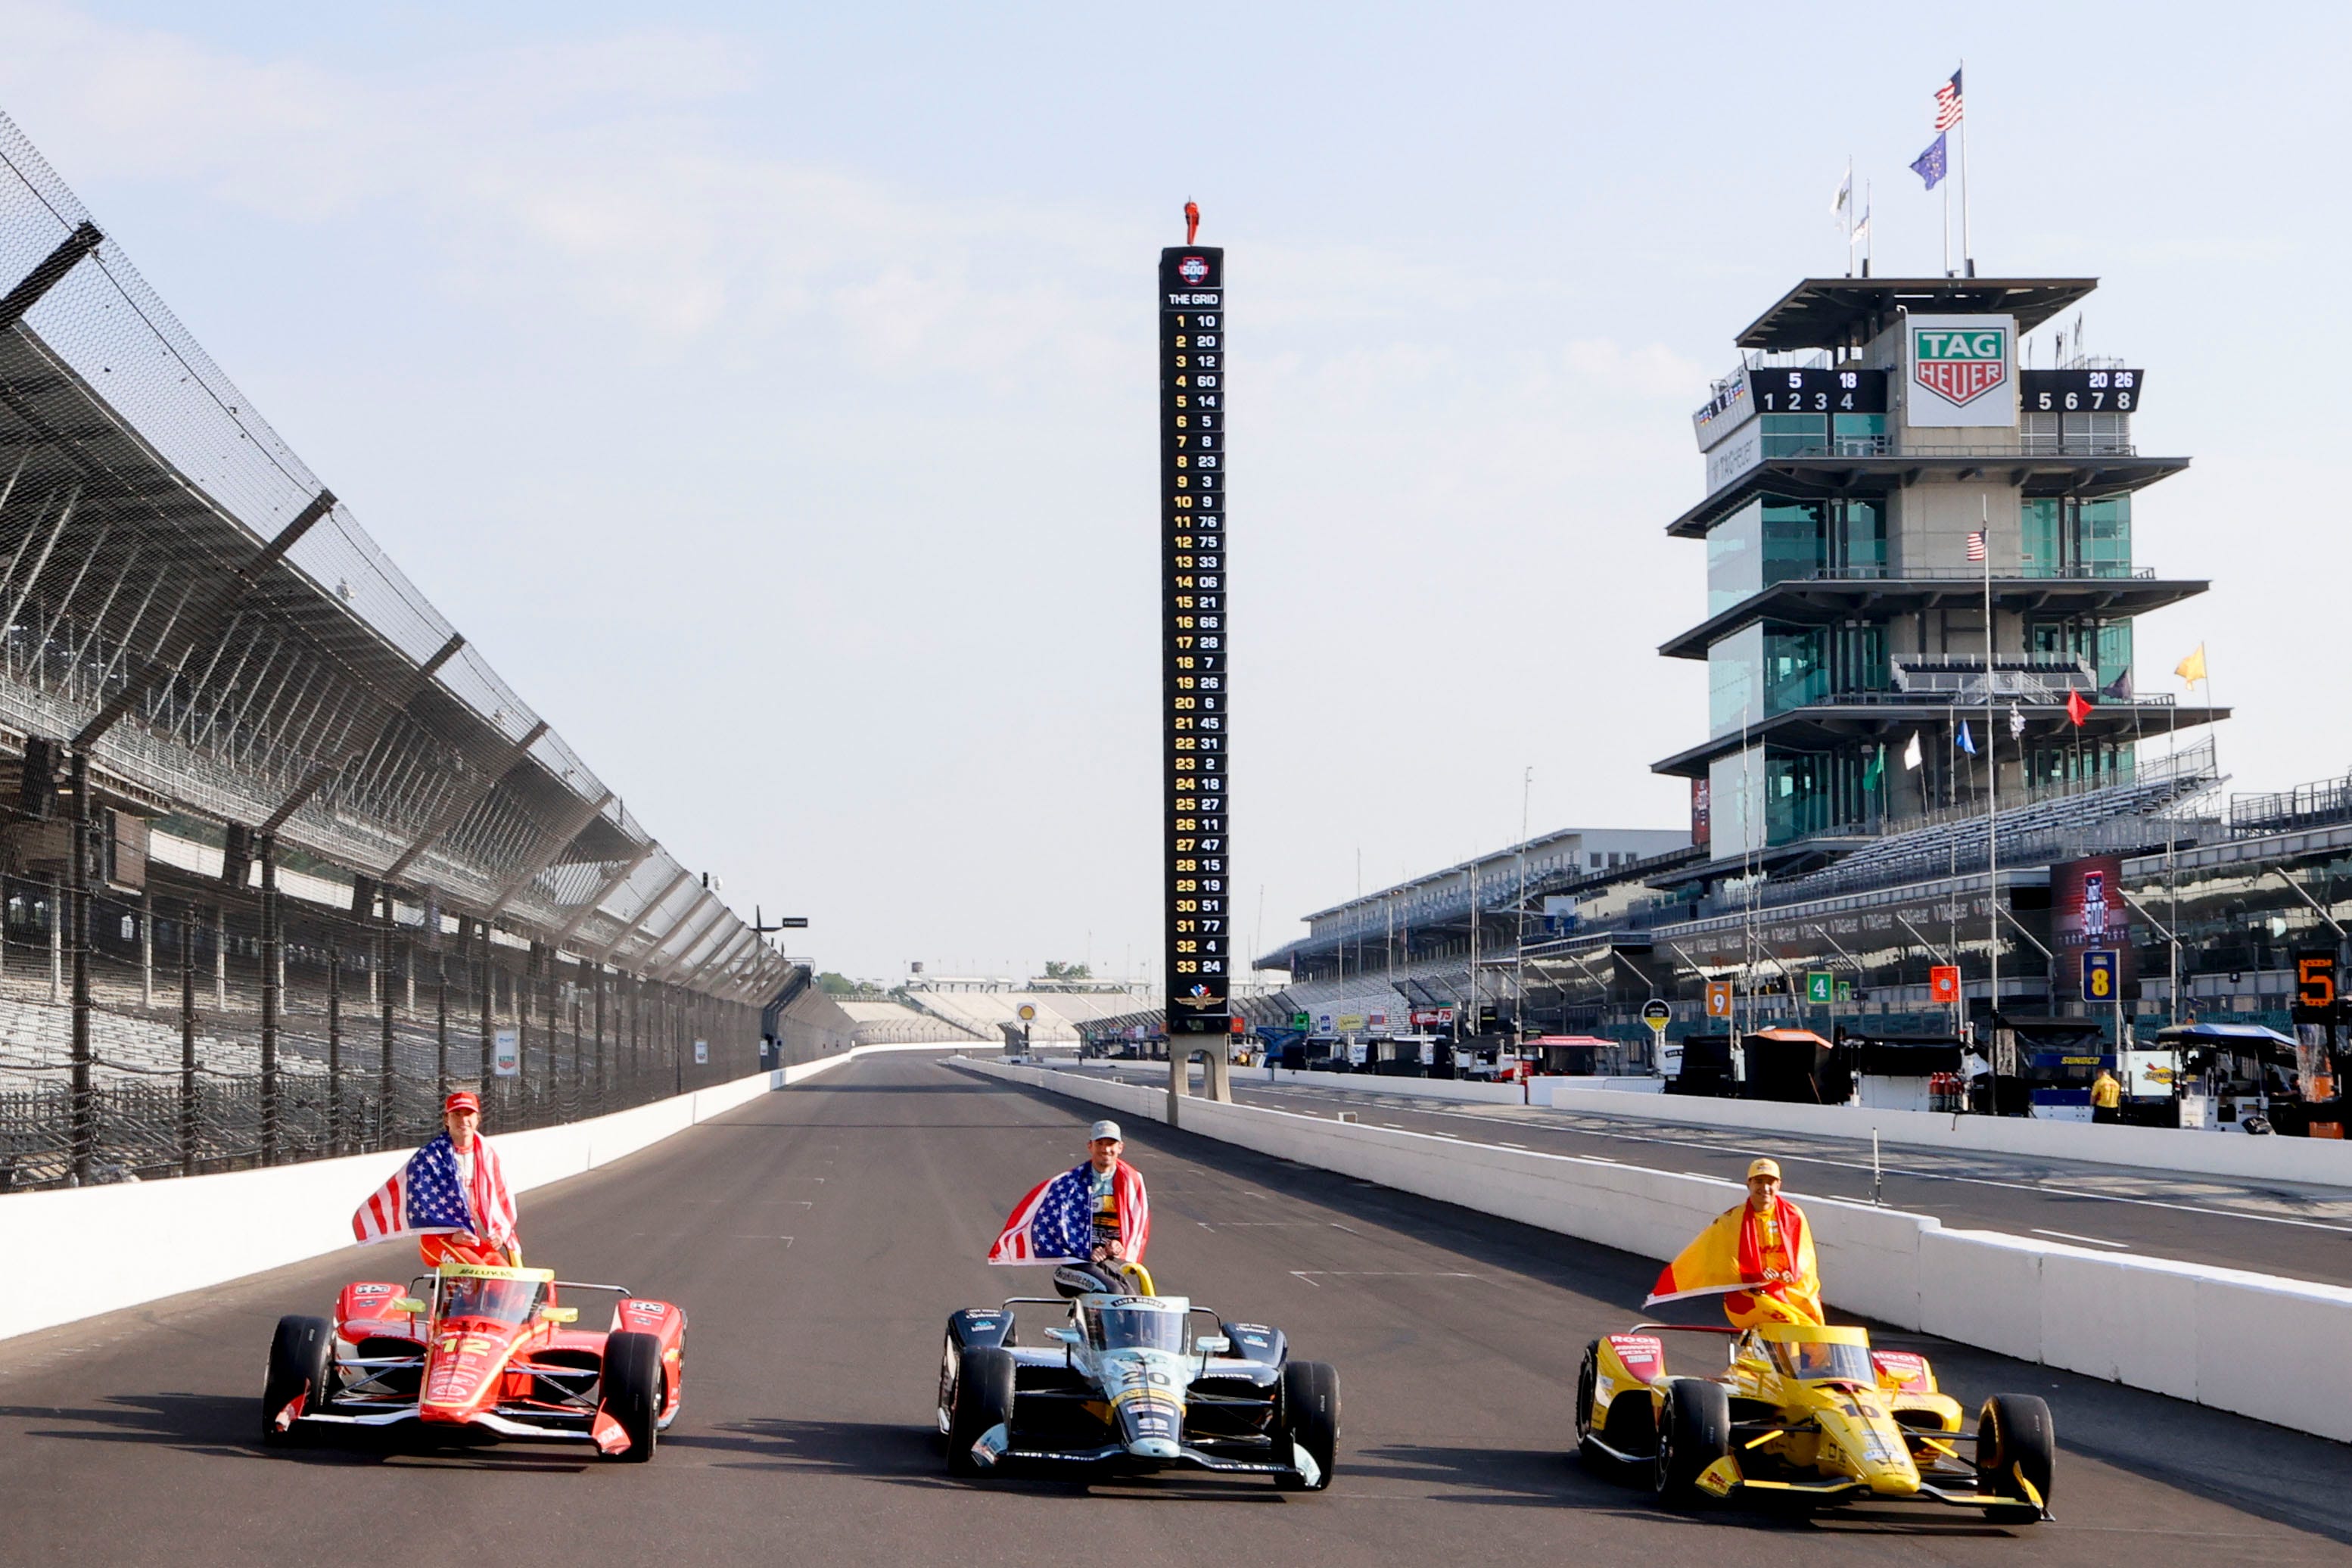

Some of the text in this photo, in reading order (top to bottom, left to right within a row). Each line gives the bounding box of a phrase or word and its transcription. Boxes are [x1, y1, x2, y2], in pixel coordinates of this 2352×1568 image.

[1182, 265, 1206, 275] 500
[1168, 294, 1218, 304] THE GRID
[1177, 315, 1216, 328] 1 10
[1176, 335, 1216, 347] 2 20
[1922, 334, 1996, 357] TAG
[1176, 355, 1215, 368] 3 12
[1175, 375, 1216, 387] 4 60
[1789, 372, 1857, 388] 5 18
[1921, 364, 1999, 400] HEUER
[2089, 372, 2133, 388] 20 26
[1176, 395, 1216, 408] 5 14
[1764, 393, 1854, 410] 1 2 3 4
[2039, 392, 2130, 410] 5 6 7 8
[1176, 415, 1212, 428] 6 5
[1177, 435, 1212, 448] 7 8
[1177, 456, 1216, 468] 8 23
[1177, 475, 1212, 488] 9 3
[1174, 496, 1212, 509] 10 9
[1174, 515, 1217, 528] 11 76
[1174, 536, 1218, 549] 12 75
[1175, 555, 1218, 568] 13 33
[1175, 576, 1218, 589] 14 06
[1175, 596, 1216, 608] 15 21
[1175, 616, 1218, 629] 16 66
[1176, 636, 1218, 649] 17 28
[1176, 656, 1214, 669] 18 7
[1176, 677, 1218, 689] 19 26
[1174, 697, 1215, 709] 20 6
[1175, 717, 1219, 730] 21 45
[1175, 737, 1218, 750] 22 31
[1175, 758, 1215, 770] 23 2
[1175, 777, 1220, 791] 24 18
[1175, 798, 1219, 810] 25 27
[1176, 818, 1218, 831] 26 11
[1176, 838, 1220, 851] 27 47
[1176, 859, 1221, 872] 28 15
[1176, 879, 1221, 892] 29 19
[1176, 899, 1218, 912] 30 51
[1176, 919, 1220, 932] 31 77
[1177, 940, 1216, 953] 32 4
[1177, 960, 1221, 973] 33 24
[1813, 978, 1827, 997] 4
[2092, 969, 2109, 997] 8
[2299, 960, 2335, 1006] 5
[1713, 994, 1725, 1013] 9
[1440, 1010, 1451, 1020] 75
[459, 1268, 515, 1278] MALUKAS
[1114, 1297, 1134, 1306] JAVA
[441, 1338, 491, 1357] 12
[1122, 1370, 1171, 1386] 20
[1840, 1405, 1881, 1418] 10
